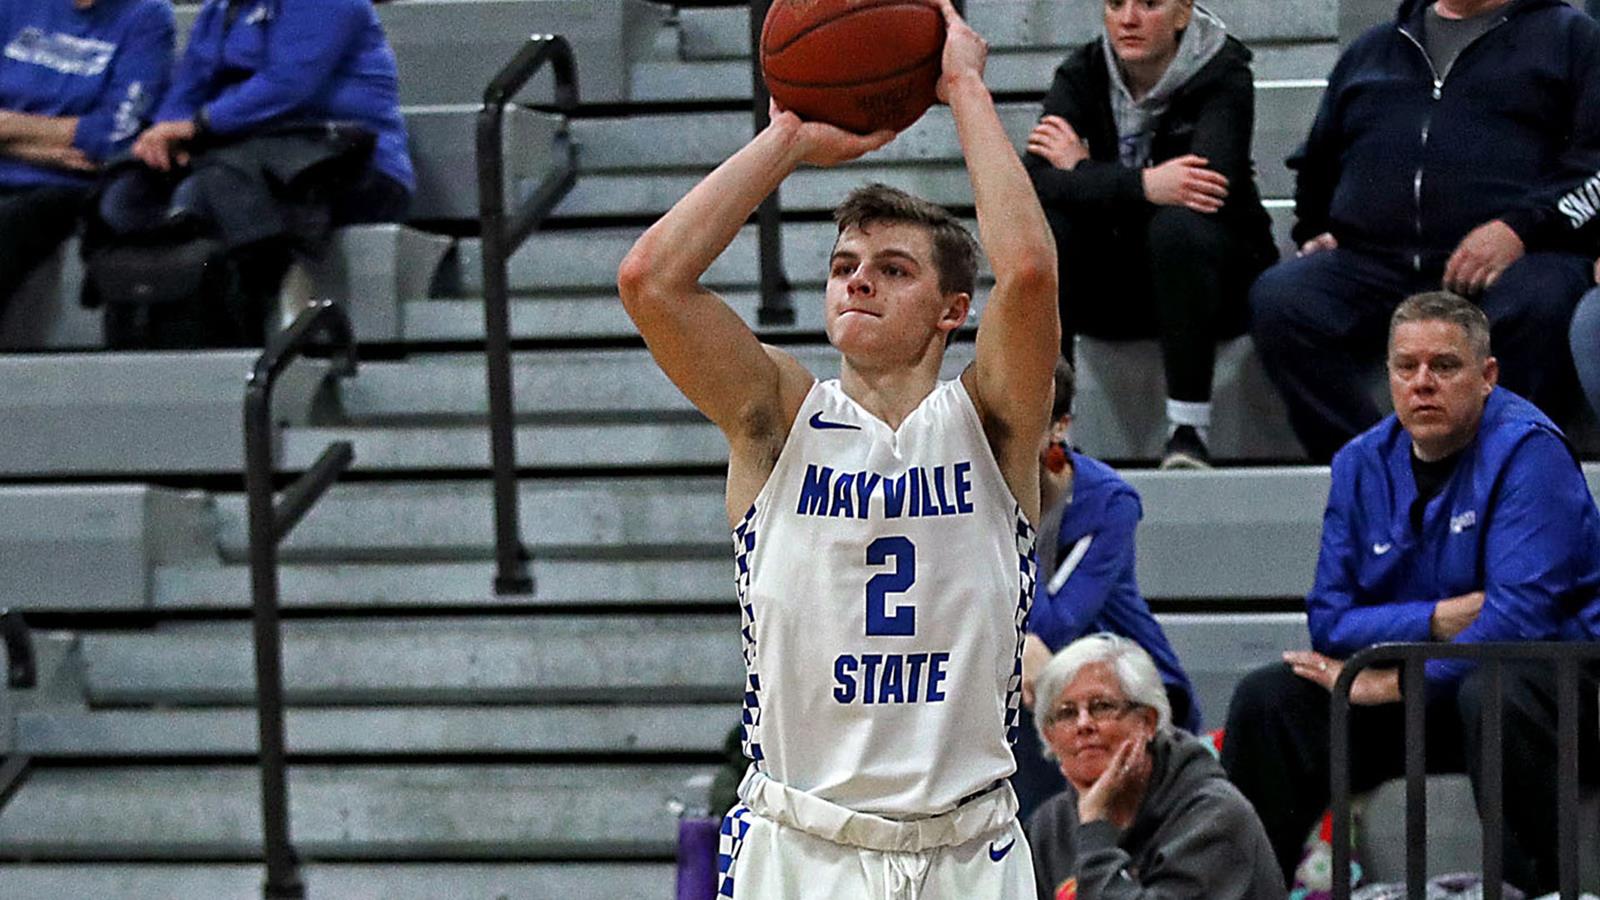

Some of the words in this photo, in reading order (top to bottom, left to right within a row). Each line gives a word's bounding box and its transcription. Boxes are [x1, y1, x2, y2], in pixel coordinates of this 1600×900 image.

[1558, 170, 1600, 229] SNO
[797, 461, 974, 519] MAYVILLE
[866, 536, 916, 636] 2
[833, 652, 950, 704] STATE
